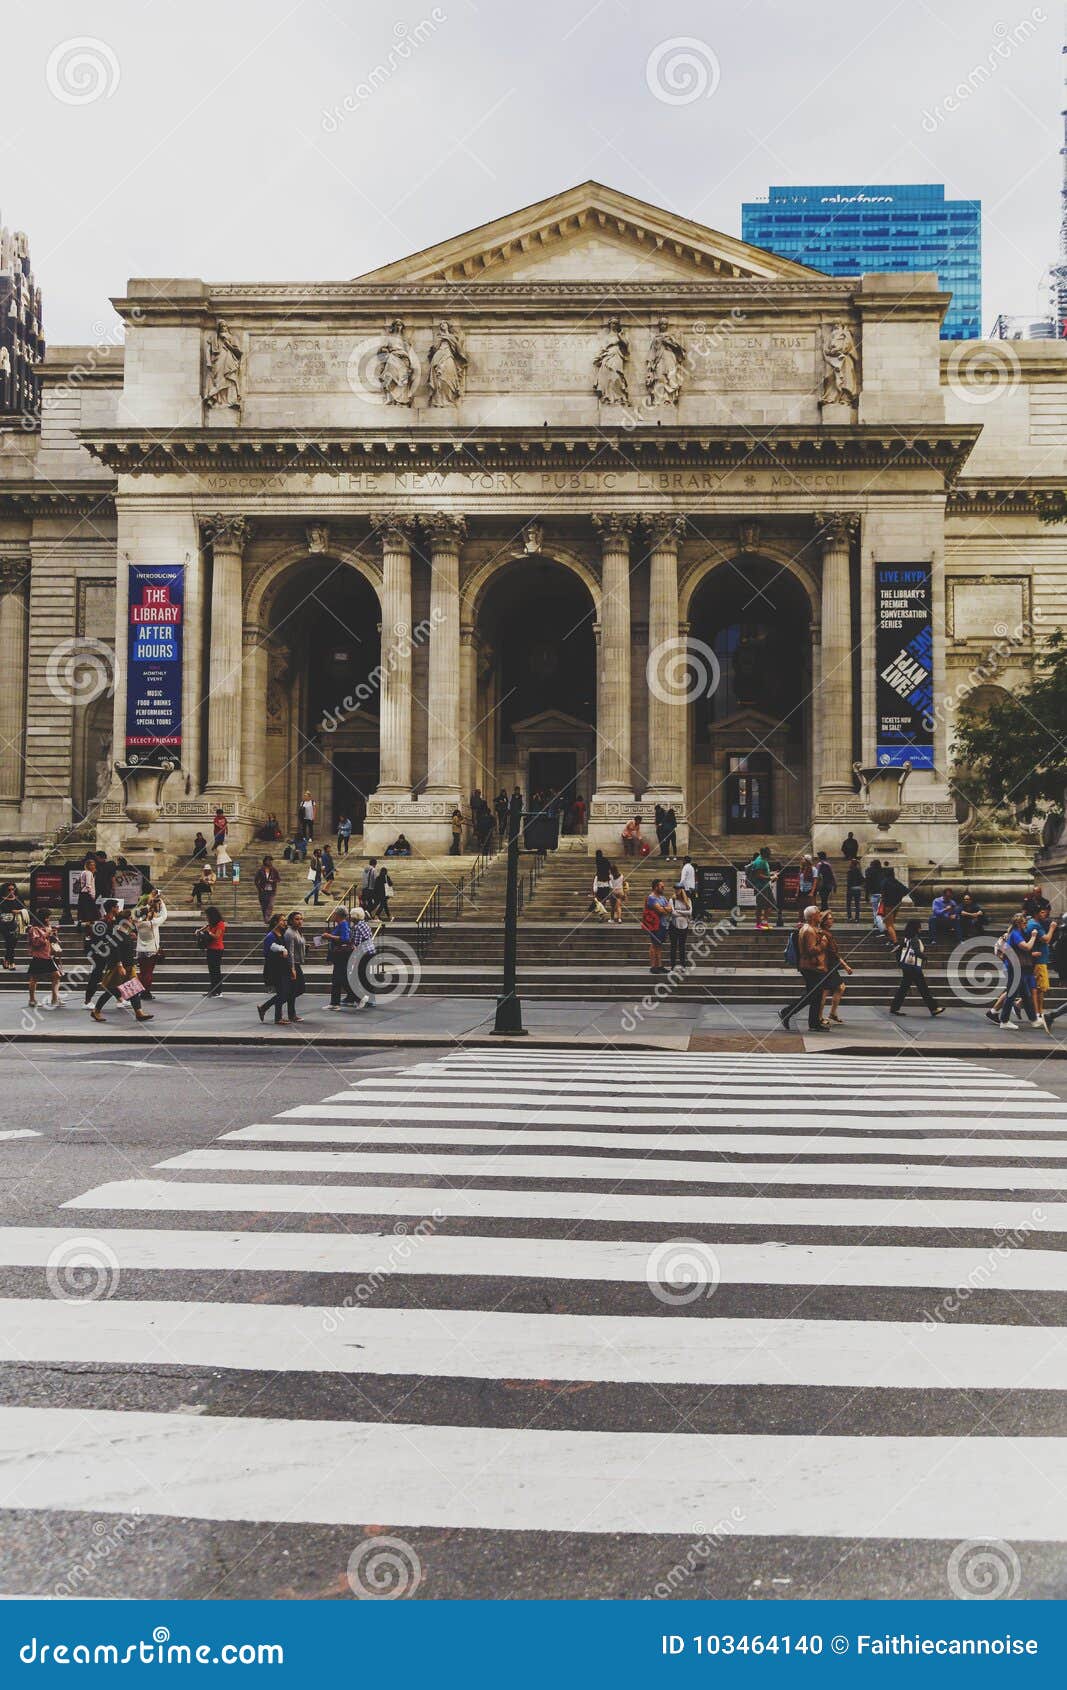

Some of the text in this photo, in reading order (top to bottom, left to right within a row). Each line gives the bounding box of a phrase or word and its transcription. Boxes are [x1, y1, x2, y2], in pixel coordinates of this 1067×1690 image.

[284, 340, 321, 350] ASTOR
[772, 338, 808, 348] TRUST
[207, 477, 288, 489] MDCCCXCV
[336, 473, 727, 490] THE NEW YORK PUBLIC LIBRARY
[880, 570, 899, 583] LIVE
[146, 589, 167, 603] THE
[881, 590, 925, 599] THE LIBRARY'S
[881, 600, 908, 609] PREMIER
[134, 607, 178, 621] LIBRARY
[881, 610, 927, 618] CONVERSATION
[881, 620, 903, 629] SERIES
[139, 626, 172, 640] AFTER
[137, 644, 173, 658] HOURS
